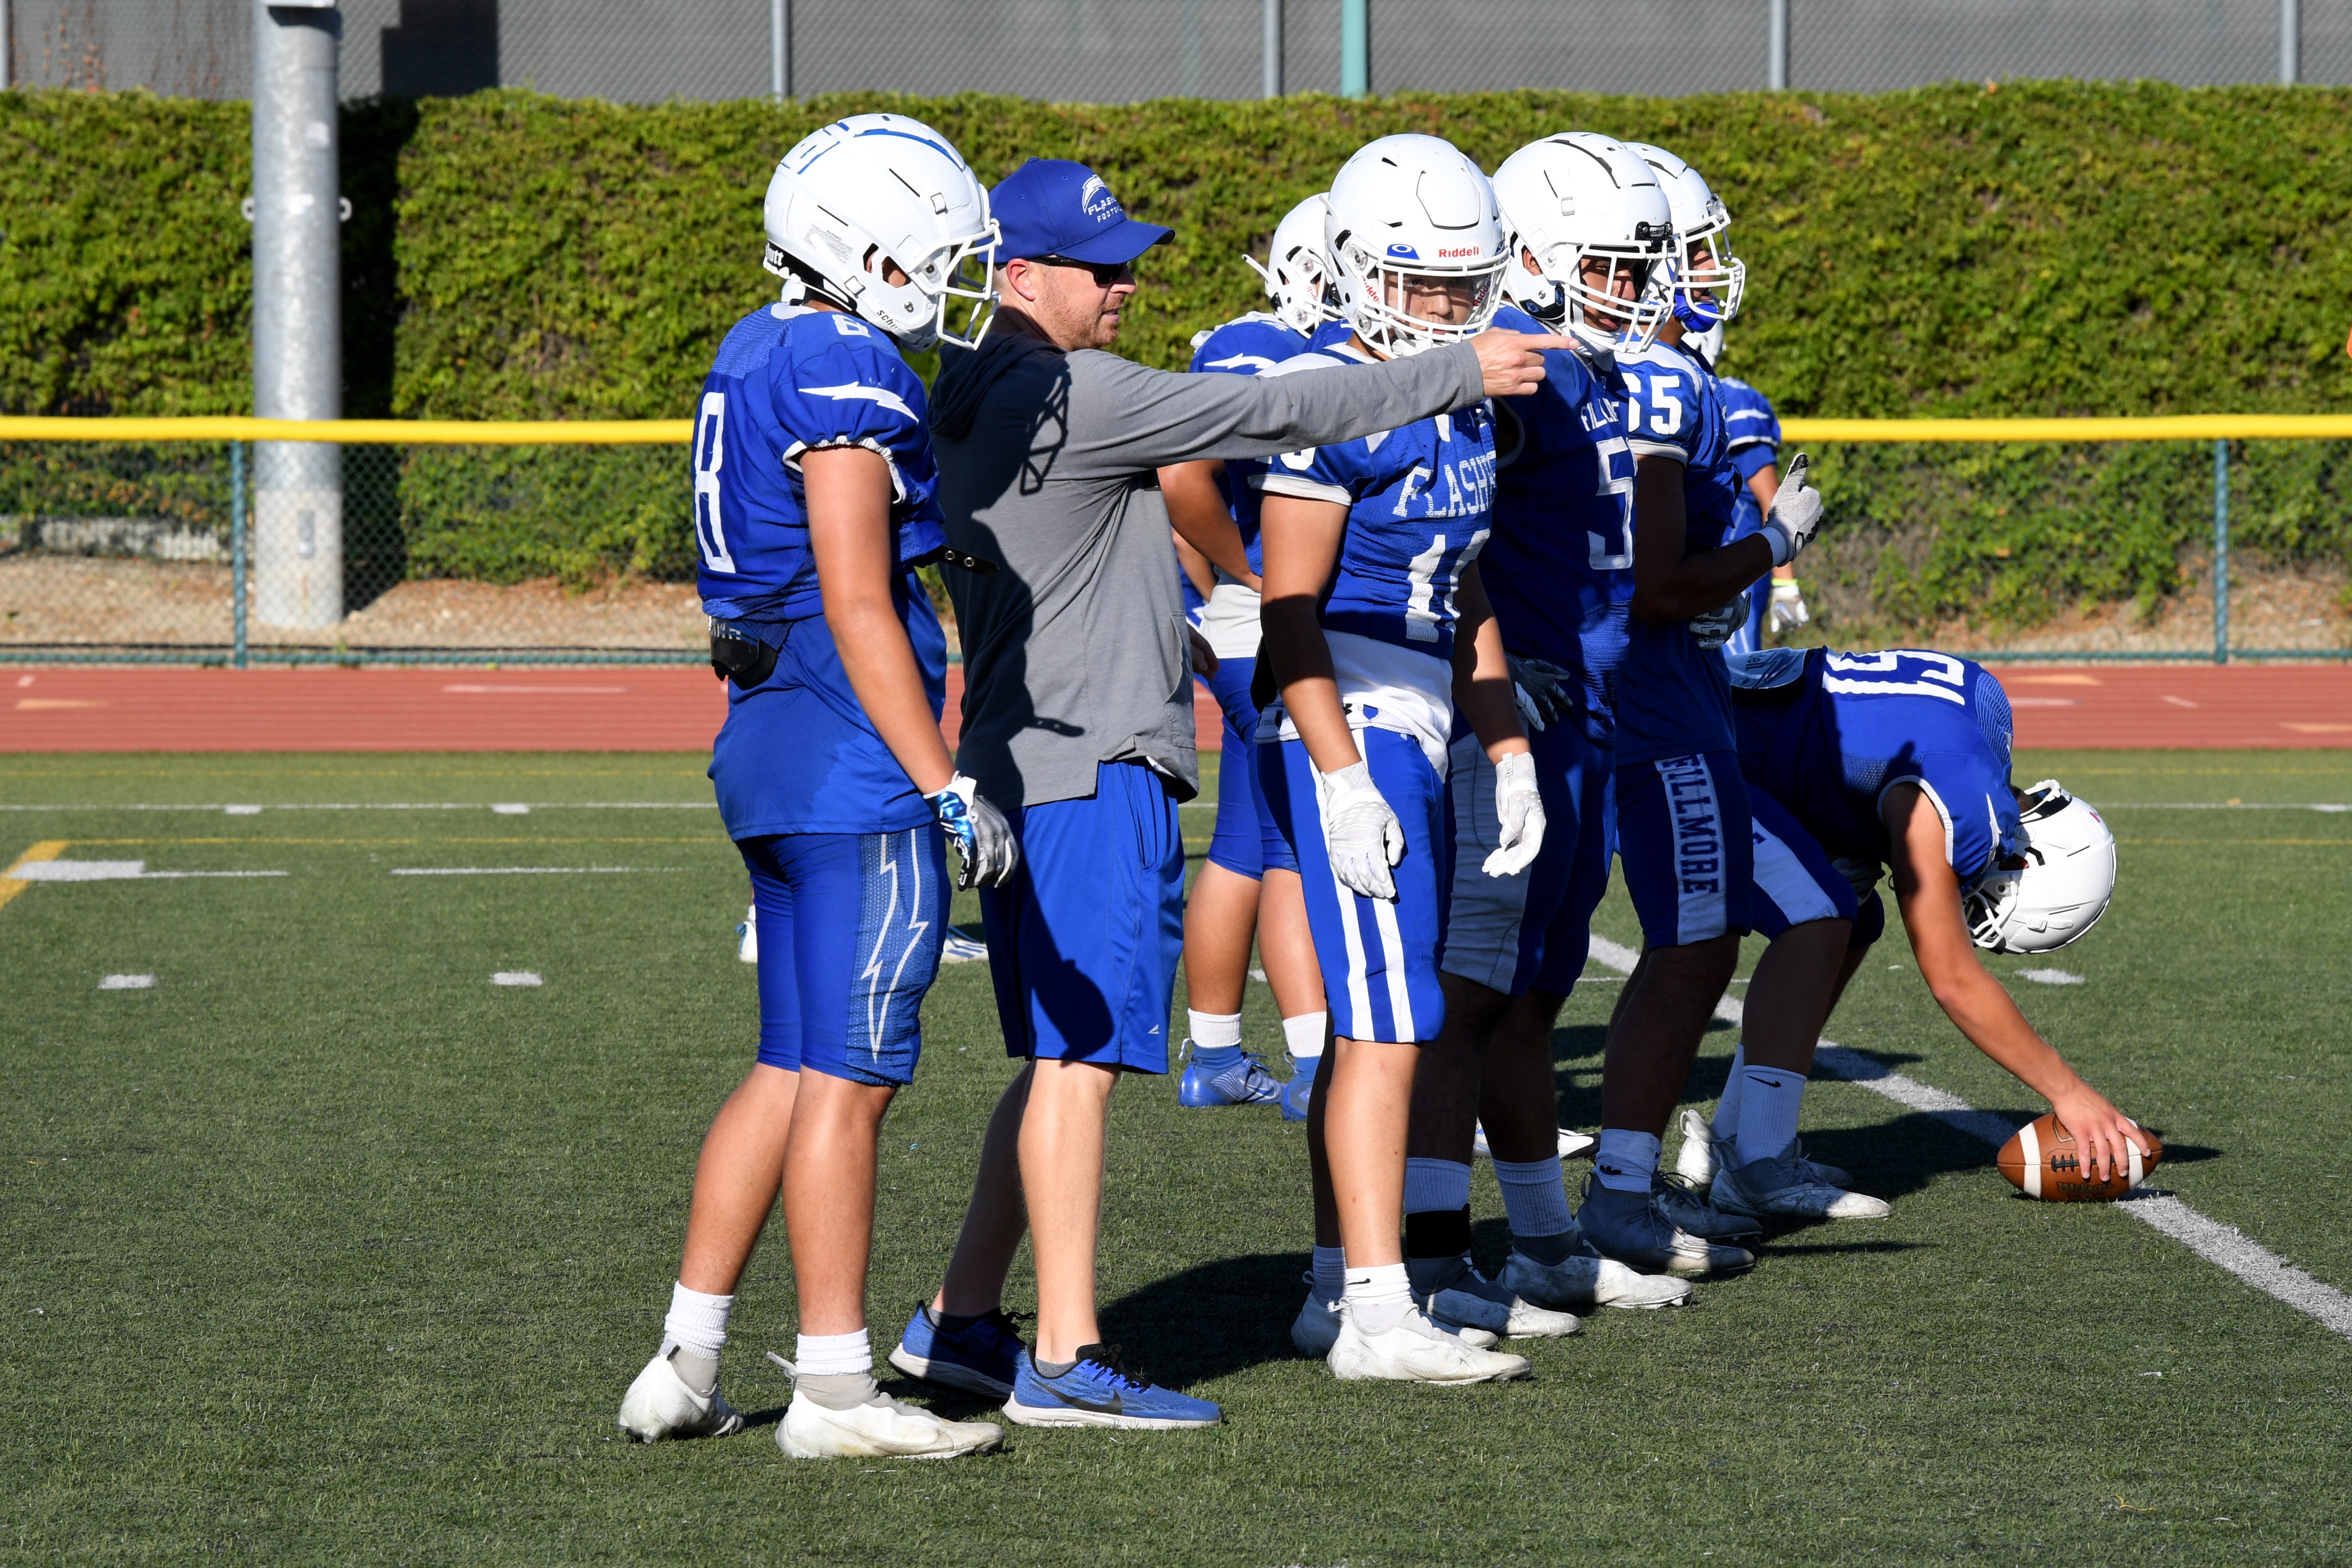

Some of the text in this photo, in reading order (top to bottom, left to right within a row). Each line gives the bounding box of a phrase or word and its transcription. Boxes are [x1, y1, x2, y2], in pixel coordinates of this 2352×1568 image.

[1439, 246, 1479, 258] Riddell
[694, 392, 736, 573] 8
[1662, 754, 1719, 894] FILLMORE
